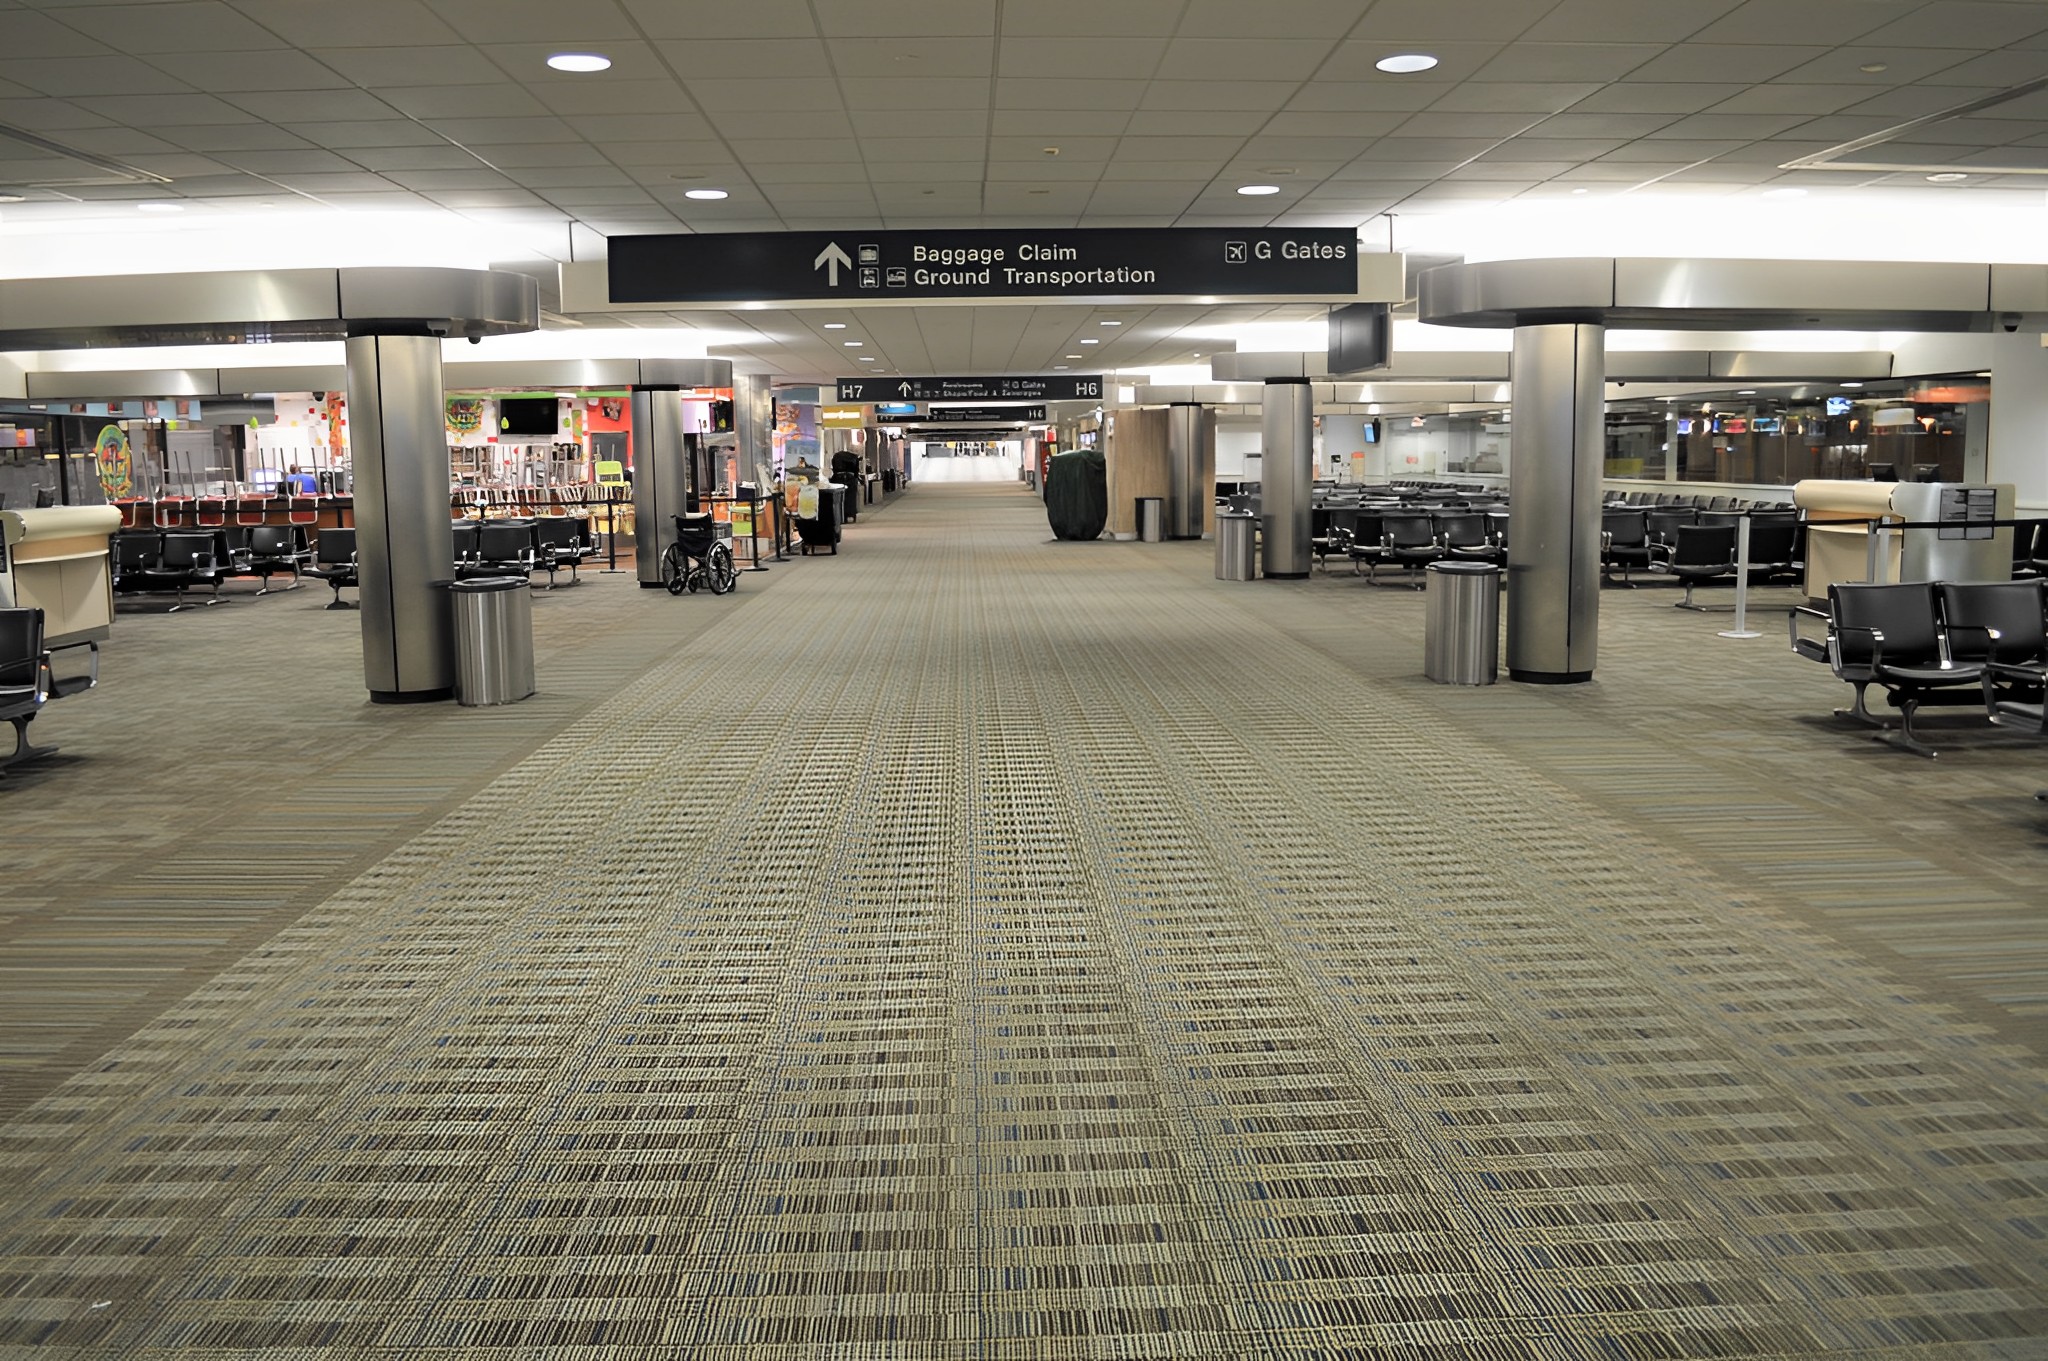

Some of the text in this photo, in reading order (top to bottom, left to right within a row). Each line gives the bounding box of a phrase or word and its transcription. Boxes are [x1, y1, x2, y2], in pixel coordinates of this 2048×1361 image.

[913, 244, 1077, 265] Baggage Claim
[1254, 240, 1347, 260] G Gates
[914, 266, 1156, 287] Ground Transportation
[842, 384, 863, 399] H7
[1075, 382, 1098, 396] H6
